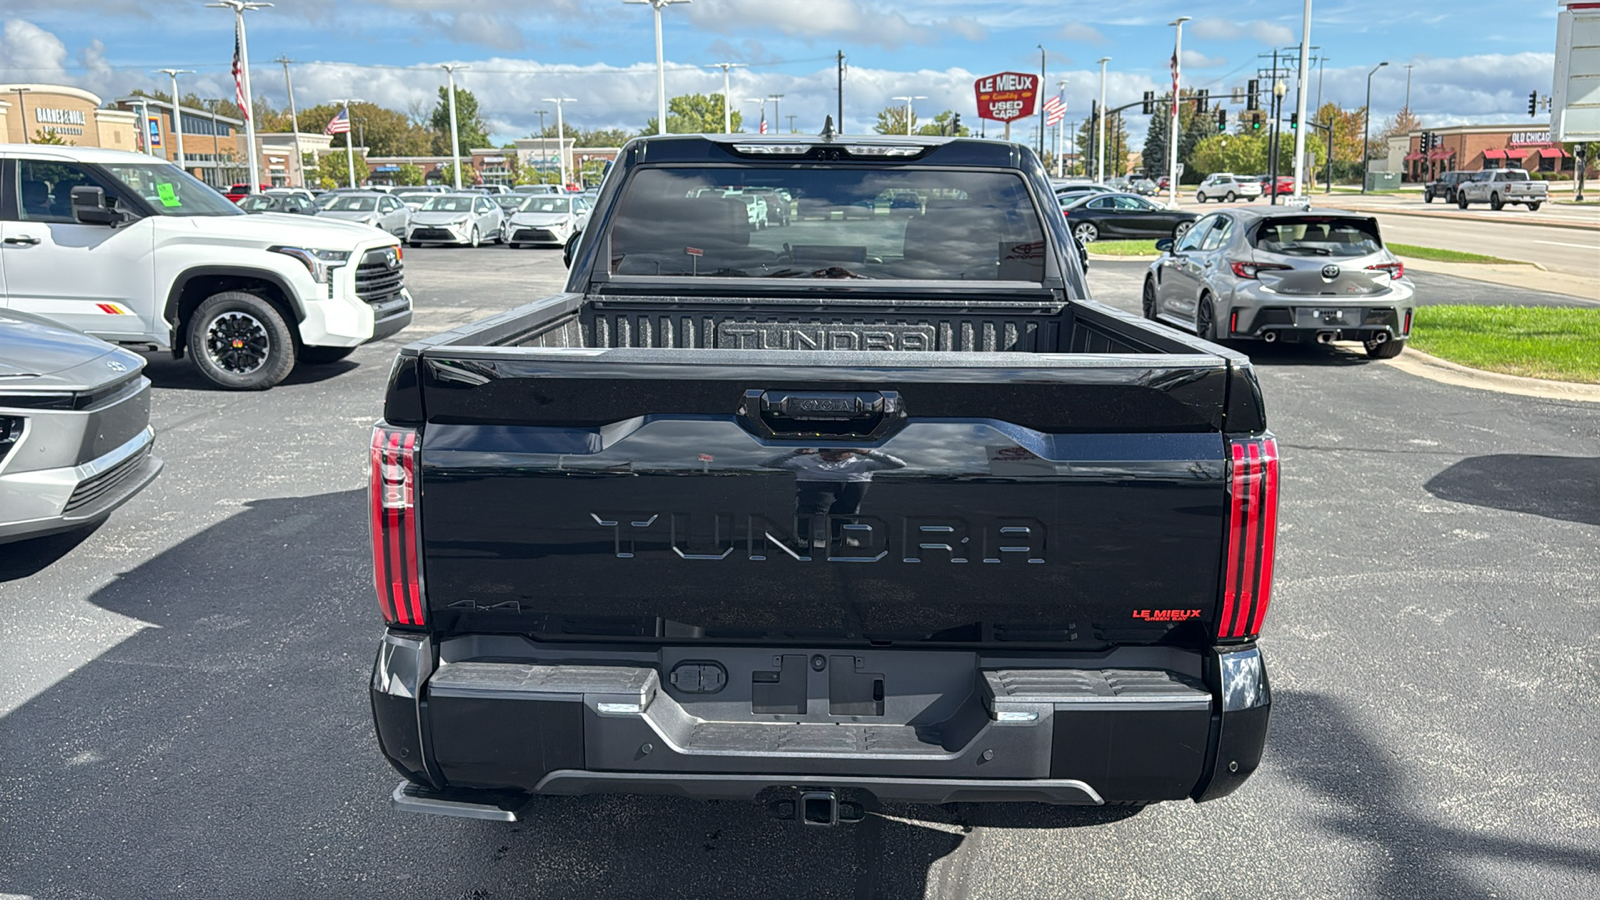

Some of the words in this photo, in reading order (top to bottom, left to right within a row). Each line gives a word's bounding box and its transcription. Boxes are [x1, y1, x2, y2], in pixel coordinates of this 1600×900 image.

[980, 79, 993, 92] LE
[996, 74, 1032, 91] MIEUX
[992, 92, 1018, 100] Quality
[989, 101, 1023, 110] USED
[993, 110, 1019, 119] CARS
[1511, 132, 1525, 143] OLD
[1526, 132, 1551, 143] CHICAG
[793, 399, 851, 412] TOYOTA
[590, 511, 1048, 564] TUNDRA
[1133, 609, 1151, 618] LE
[1154, 609, 1201, 618] MIEUX
